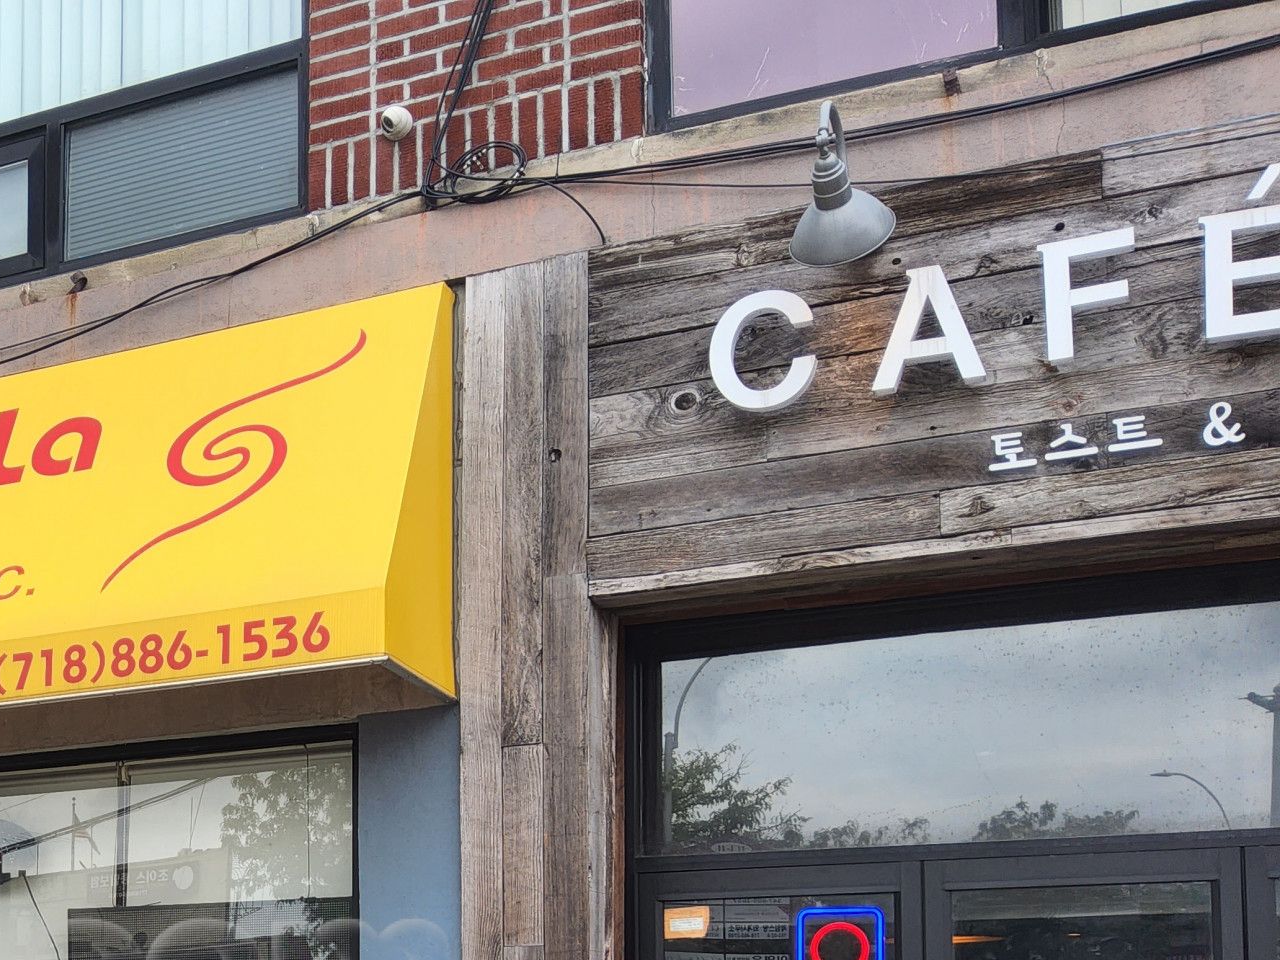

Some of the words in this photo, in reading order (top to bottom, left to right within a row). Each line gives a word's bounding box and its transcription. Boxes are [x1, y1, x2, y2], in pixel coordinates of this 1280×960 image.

[709, 164, 1280, 412] CAFÉ
[988, 415, 1163, 472] 토스트
[1202, 401, 1247, 447] &
